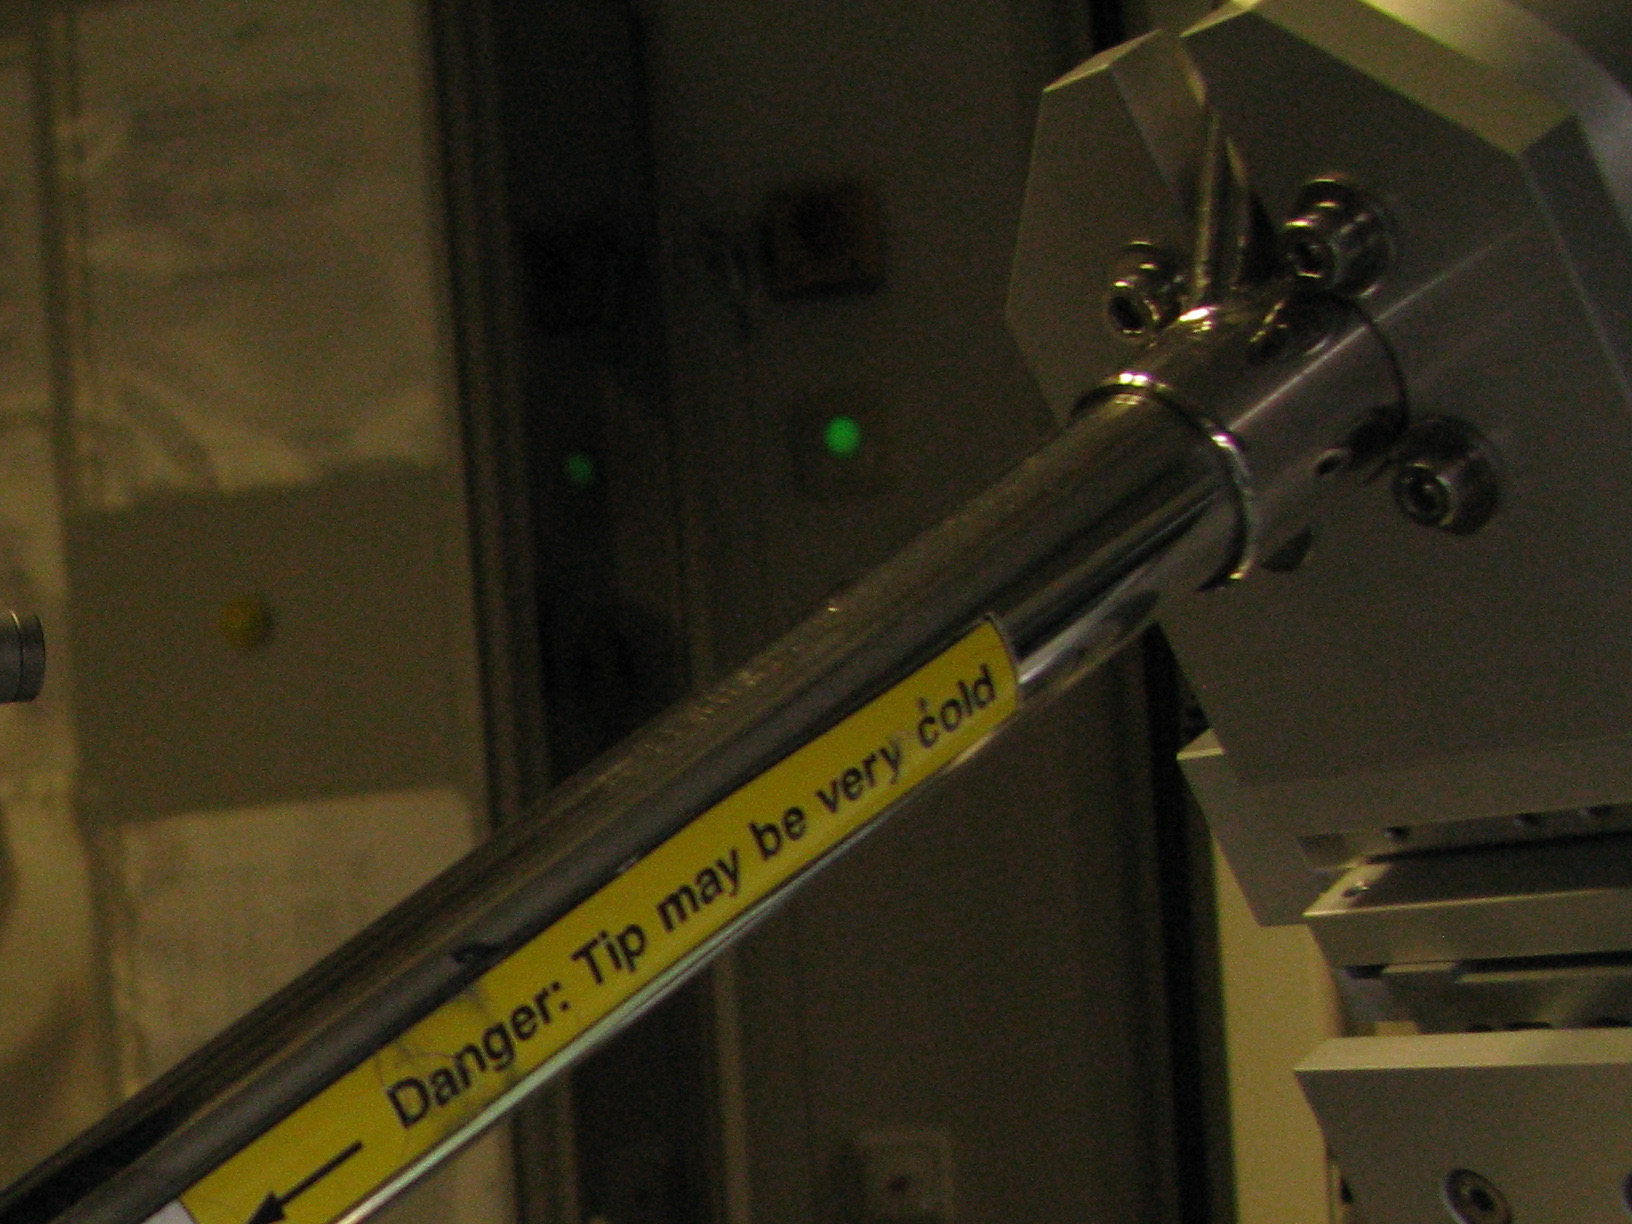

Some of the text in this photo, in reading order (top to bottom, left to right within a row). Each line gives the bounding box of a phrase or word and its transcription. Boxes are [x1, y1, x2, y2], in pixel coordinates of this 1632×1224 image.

[385, 663, 997, 1130] Danger: Tip may be very cold
